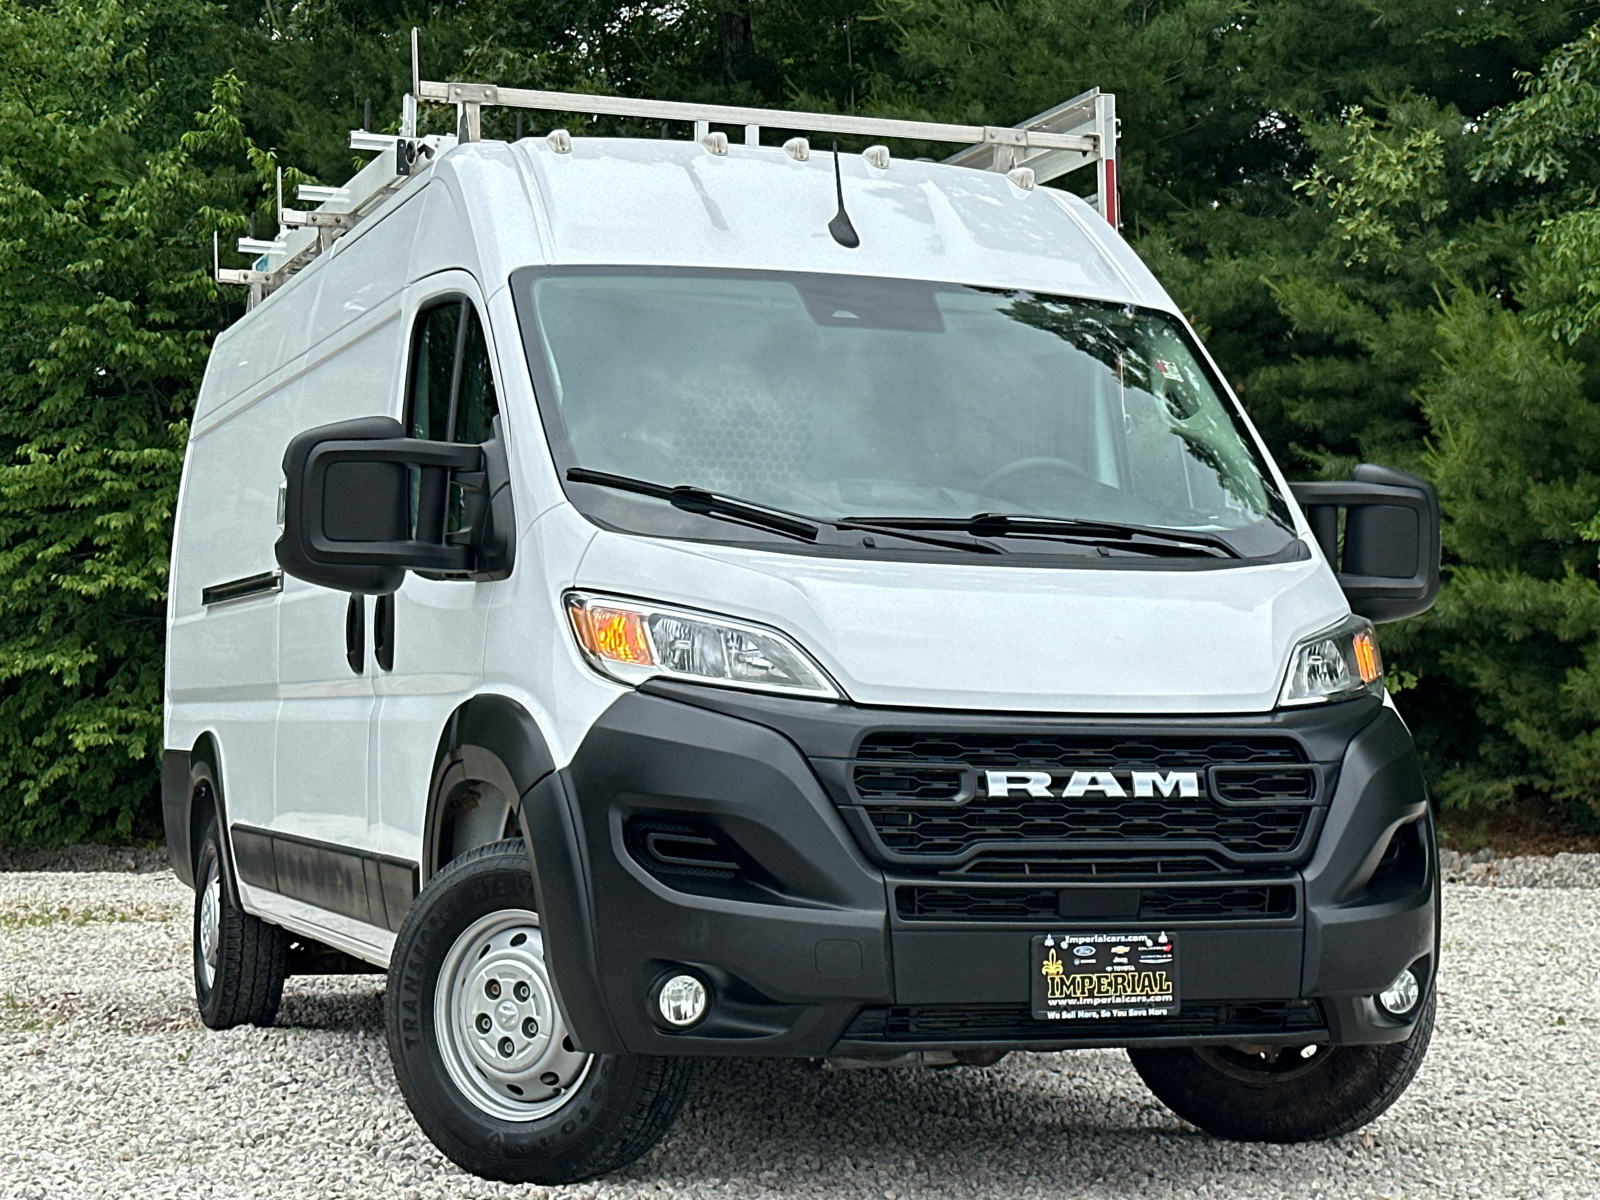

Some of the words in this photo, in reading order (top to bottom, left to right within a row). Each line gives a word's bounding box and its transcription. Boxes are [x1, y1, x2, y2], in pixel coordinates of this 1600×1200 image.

[985, 770, 1199, 798] RAM
[1047, 972, 1173, 998] IMPERIAL
[1047, 995, 1173, 1006] www.imperialcars.com
[1047, 1011, 1060, 1019] We
[1061, 1010, 1076, 1019] Sell
[1100, 1009, 1111, 1017] So
[1112, 1008, 1128, 1017] You
[1128, 1008, 1147, 1017] Save
[1148, 1008, 1168, 1016] More
